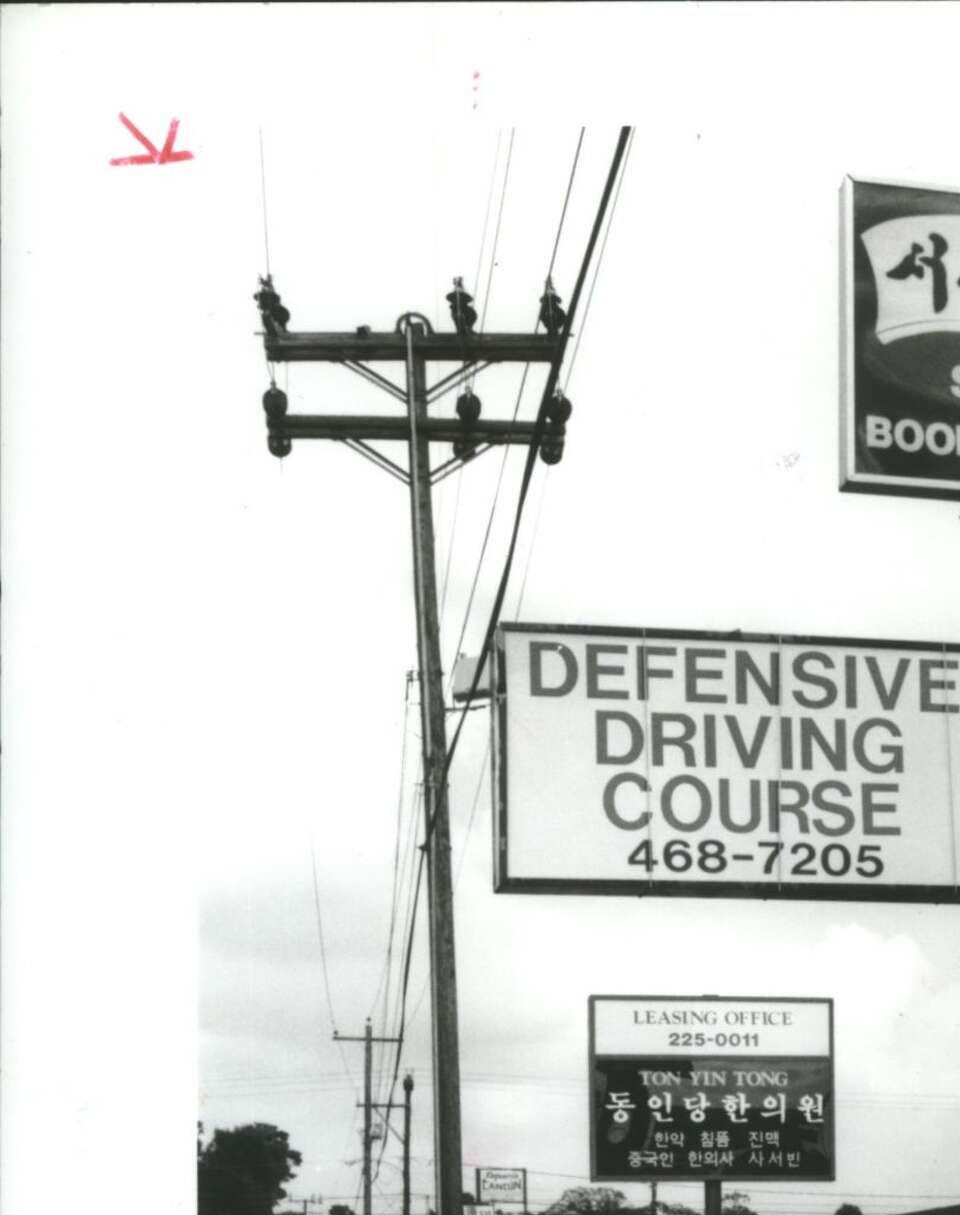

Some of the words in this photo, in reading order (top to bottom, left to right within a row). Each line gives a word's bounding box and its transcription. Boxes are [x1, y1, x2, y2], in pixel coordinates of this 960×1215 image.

[529, 641, 960, 714] DEFENSIVE
[595, 709, 905, 774] DRIVING
[602, 772, 902, 837] COURSE
[627, 839, 885, 878] 468-7205
[633, 1010, 717, 1026] LEASING
[724, 1011, 793, 1027] OFFICE
[668, 1032, 759, 1048] 225-0011
[639, 1070, 681, 1087] TON
[690, 1071, 727, 1087] YIN
[735, 1071, 789, 1088] TONG
